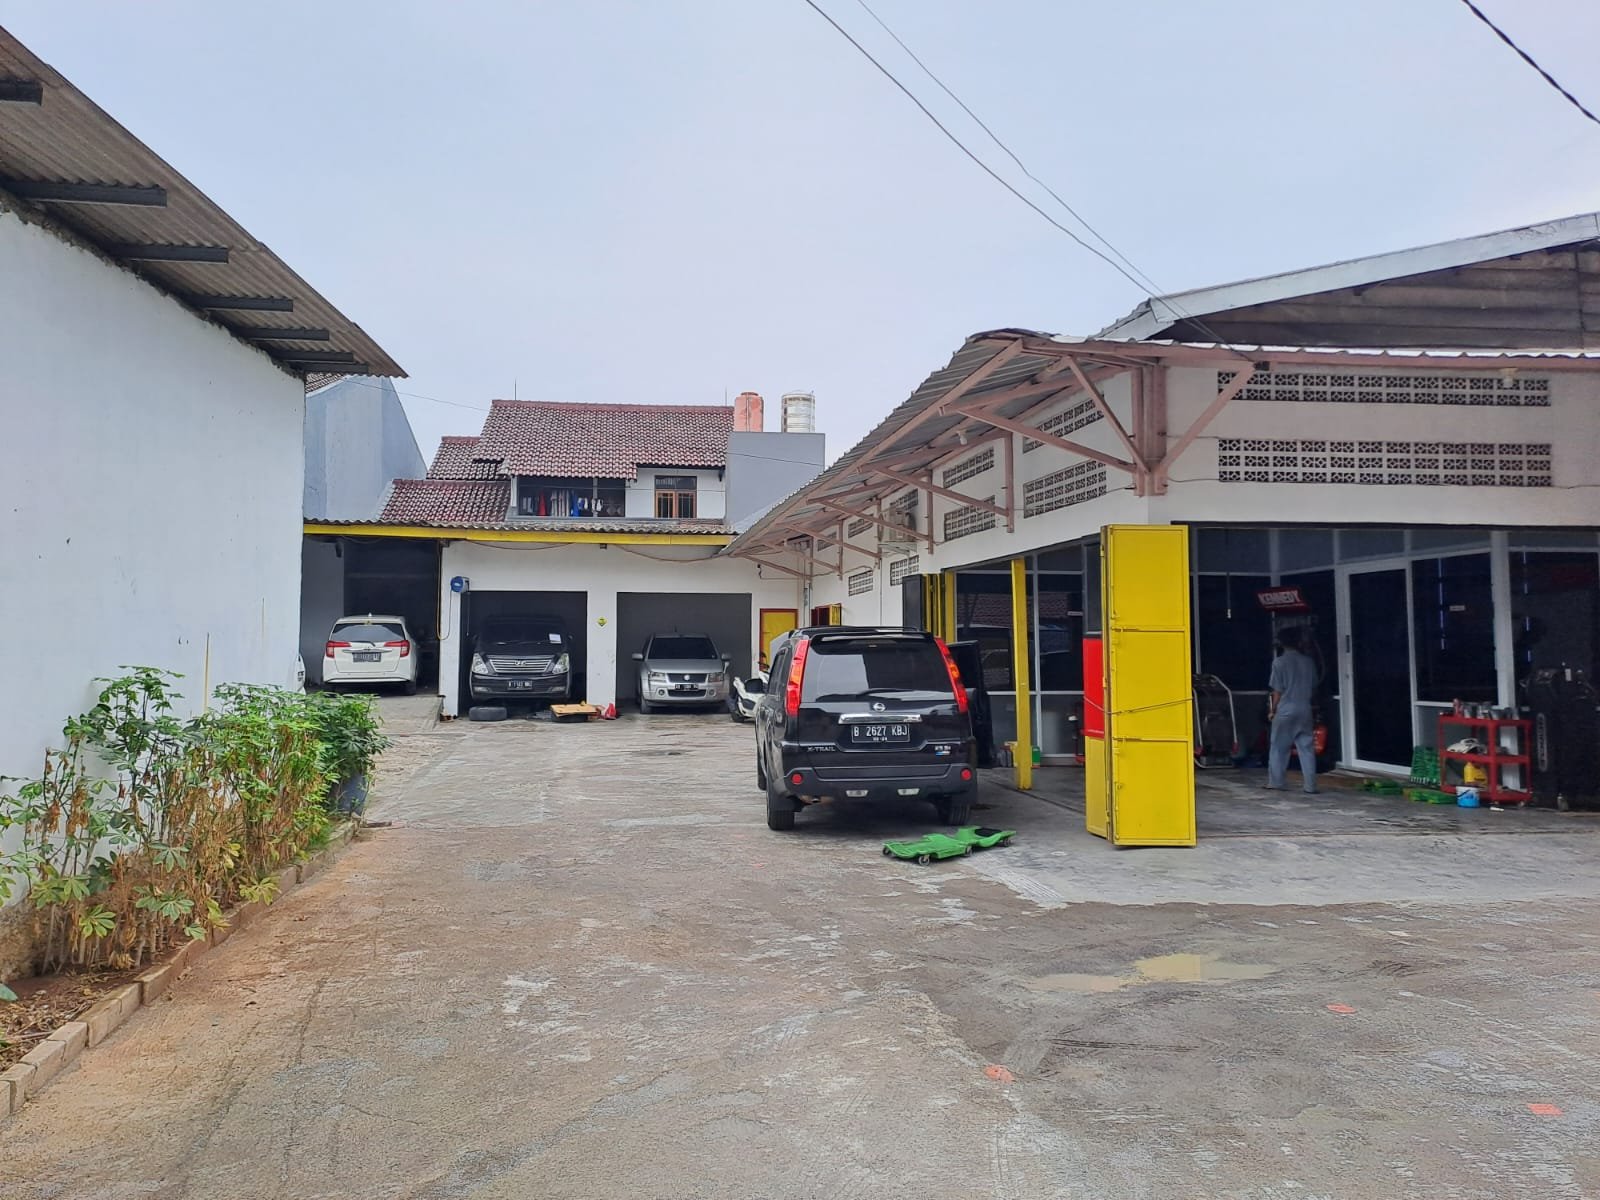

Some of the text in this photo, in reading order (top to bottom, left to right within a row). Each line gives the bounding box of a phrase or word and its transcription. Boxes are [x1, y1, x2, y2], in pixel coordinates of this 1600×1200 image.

[1257, 589, 1301, 606] KENNEDY
[853, 725, 908, 737] B 2627 KBJ
